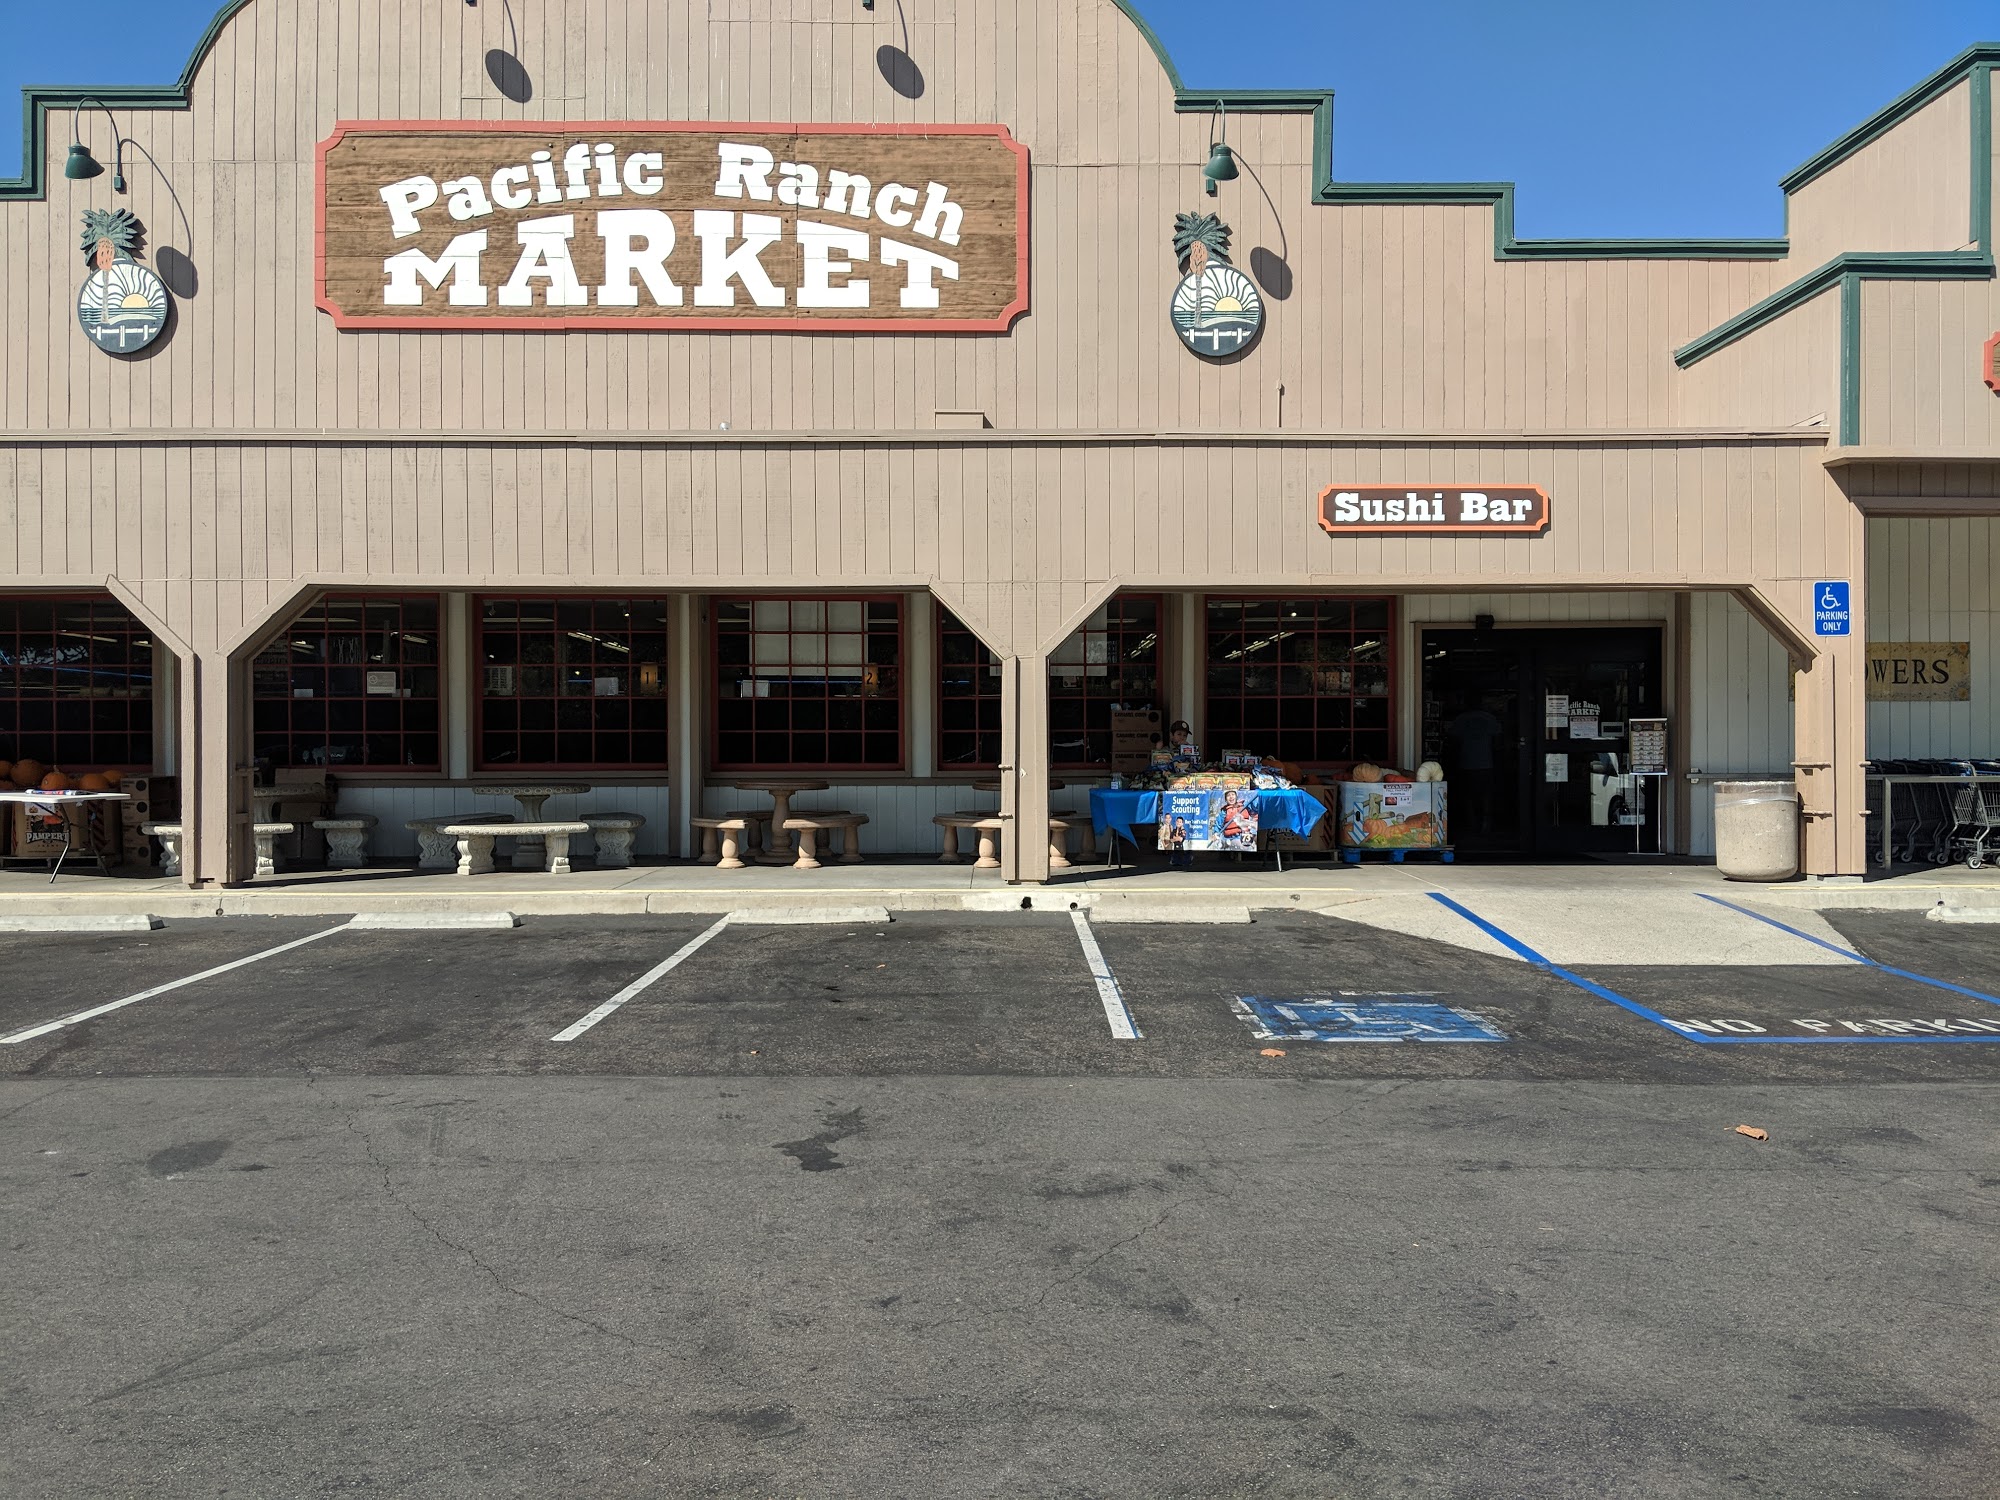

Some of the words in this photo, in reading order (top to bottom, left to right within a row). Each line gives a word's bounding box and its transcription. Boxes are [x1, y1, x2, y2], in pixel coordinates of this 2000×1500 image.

[379, 142, 664, 240] Pacific
[714, 142, 965, 246] Ranch
[383, 209, 960, 308] MARKET
[1334, 492, 1446, 522] Sushi
[1460, 492, 1533, 522] Bar
[1816, 611, 1848, 621] PARKING
[1822, 622, 1842, 631] ONLY
[1172, 796, 1200, 806] Support
[1171, 805, 1200, 815] Scouting
[1661, 1018, 1767, 1033] NO
